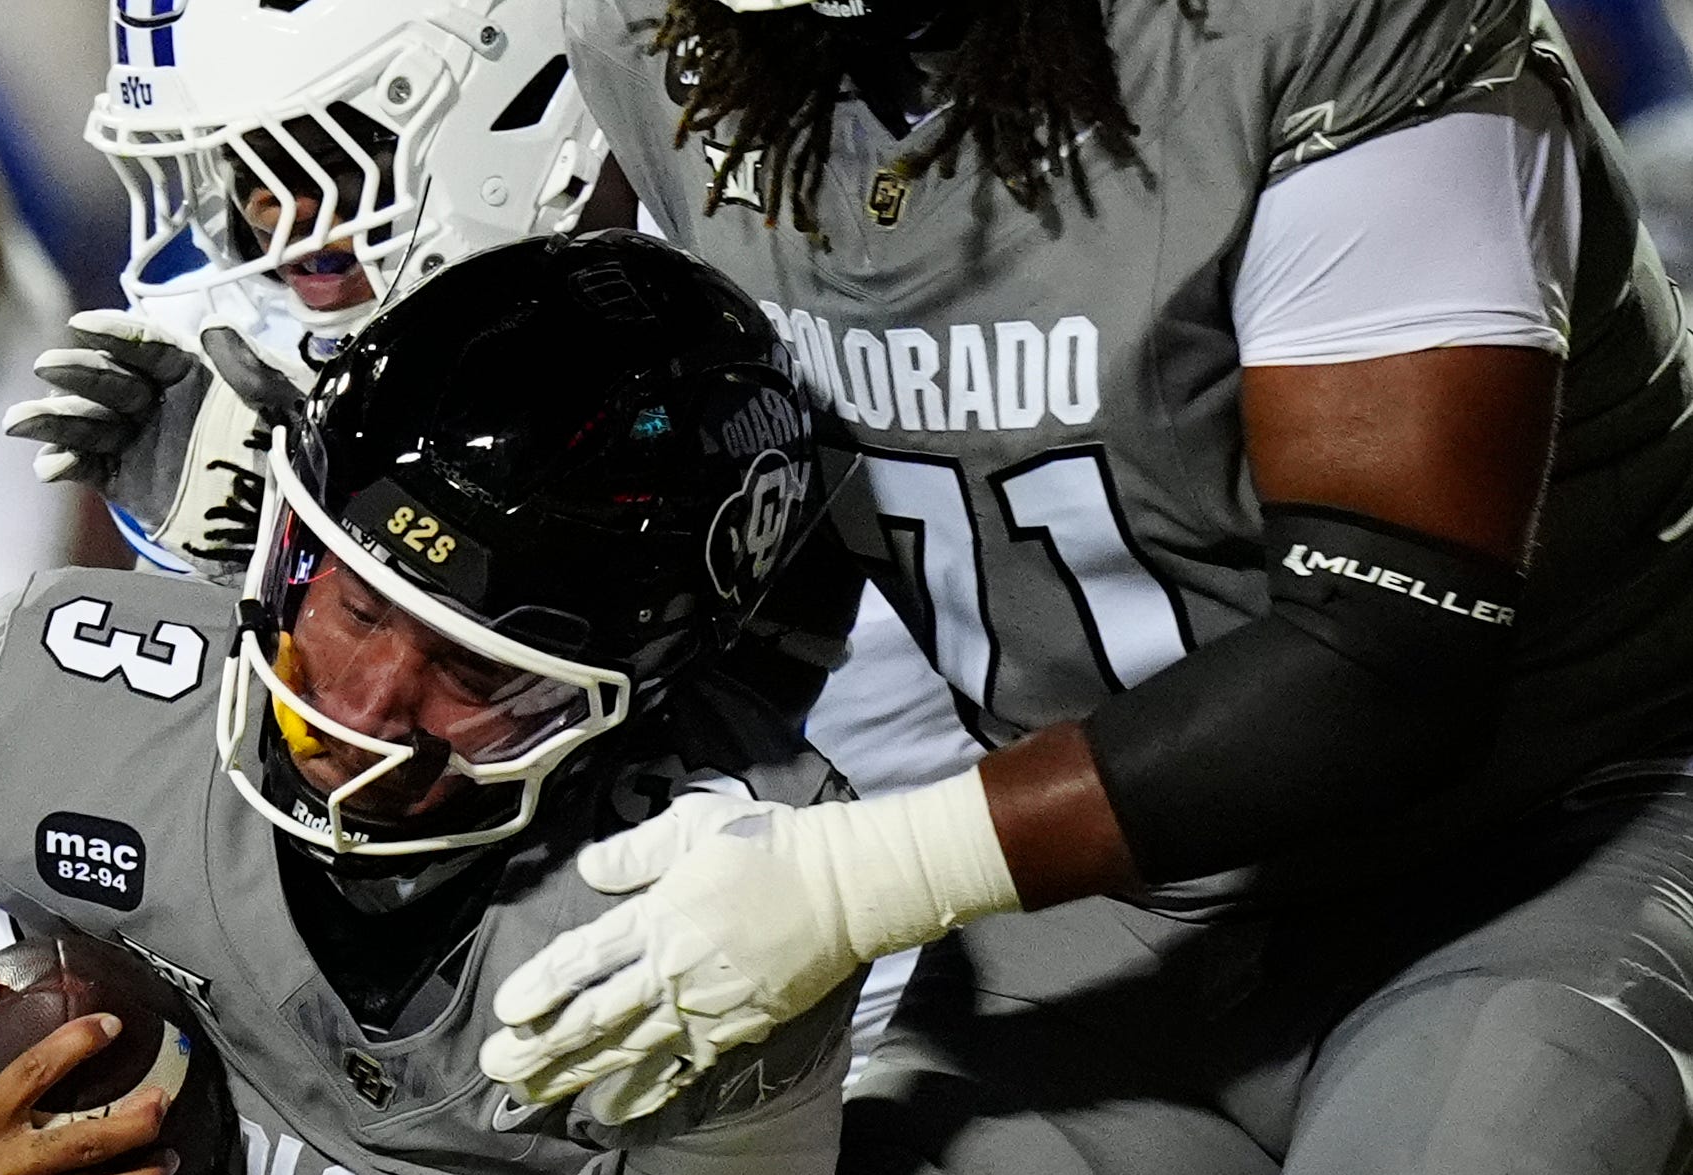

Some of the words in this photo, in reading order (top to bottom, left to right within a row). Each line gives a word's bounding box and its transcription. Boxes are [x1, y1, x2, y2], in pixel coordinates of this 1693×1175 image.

[120, 76, 153, 109] BYU
[387, 506, 457, 564] S2S
[819, 441, 1199, 710] 71
[1306, 551, 1516, 627] MUELLER
[41, 595, 209, 703] 3
[46, 829, 138, 871] mac
[58, 860, 128, 893] 82-94
